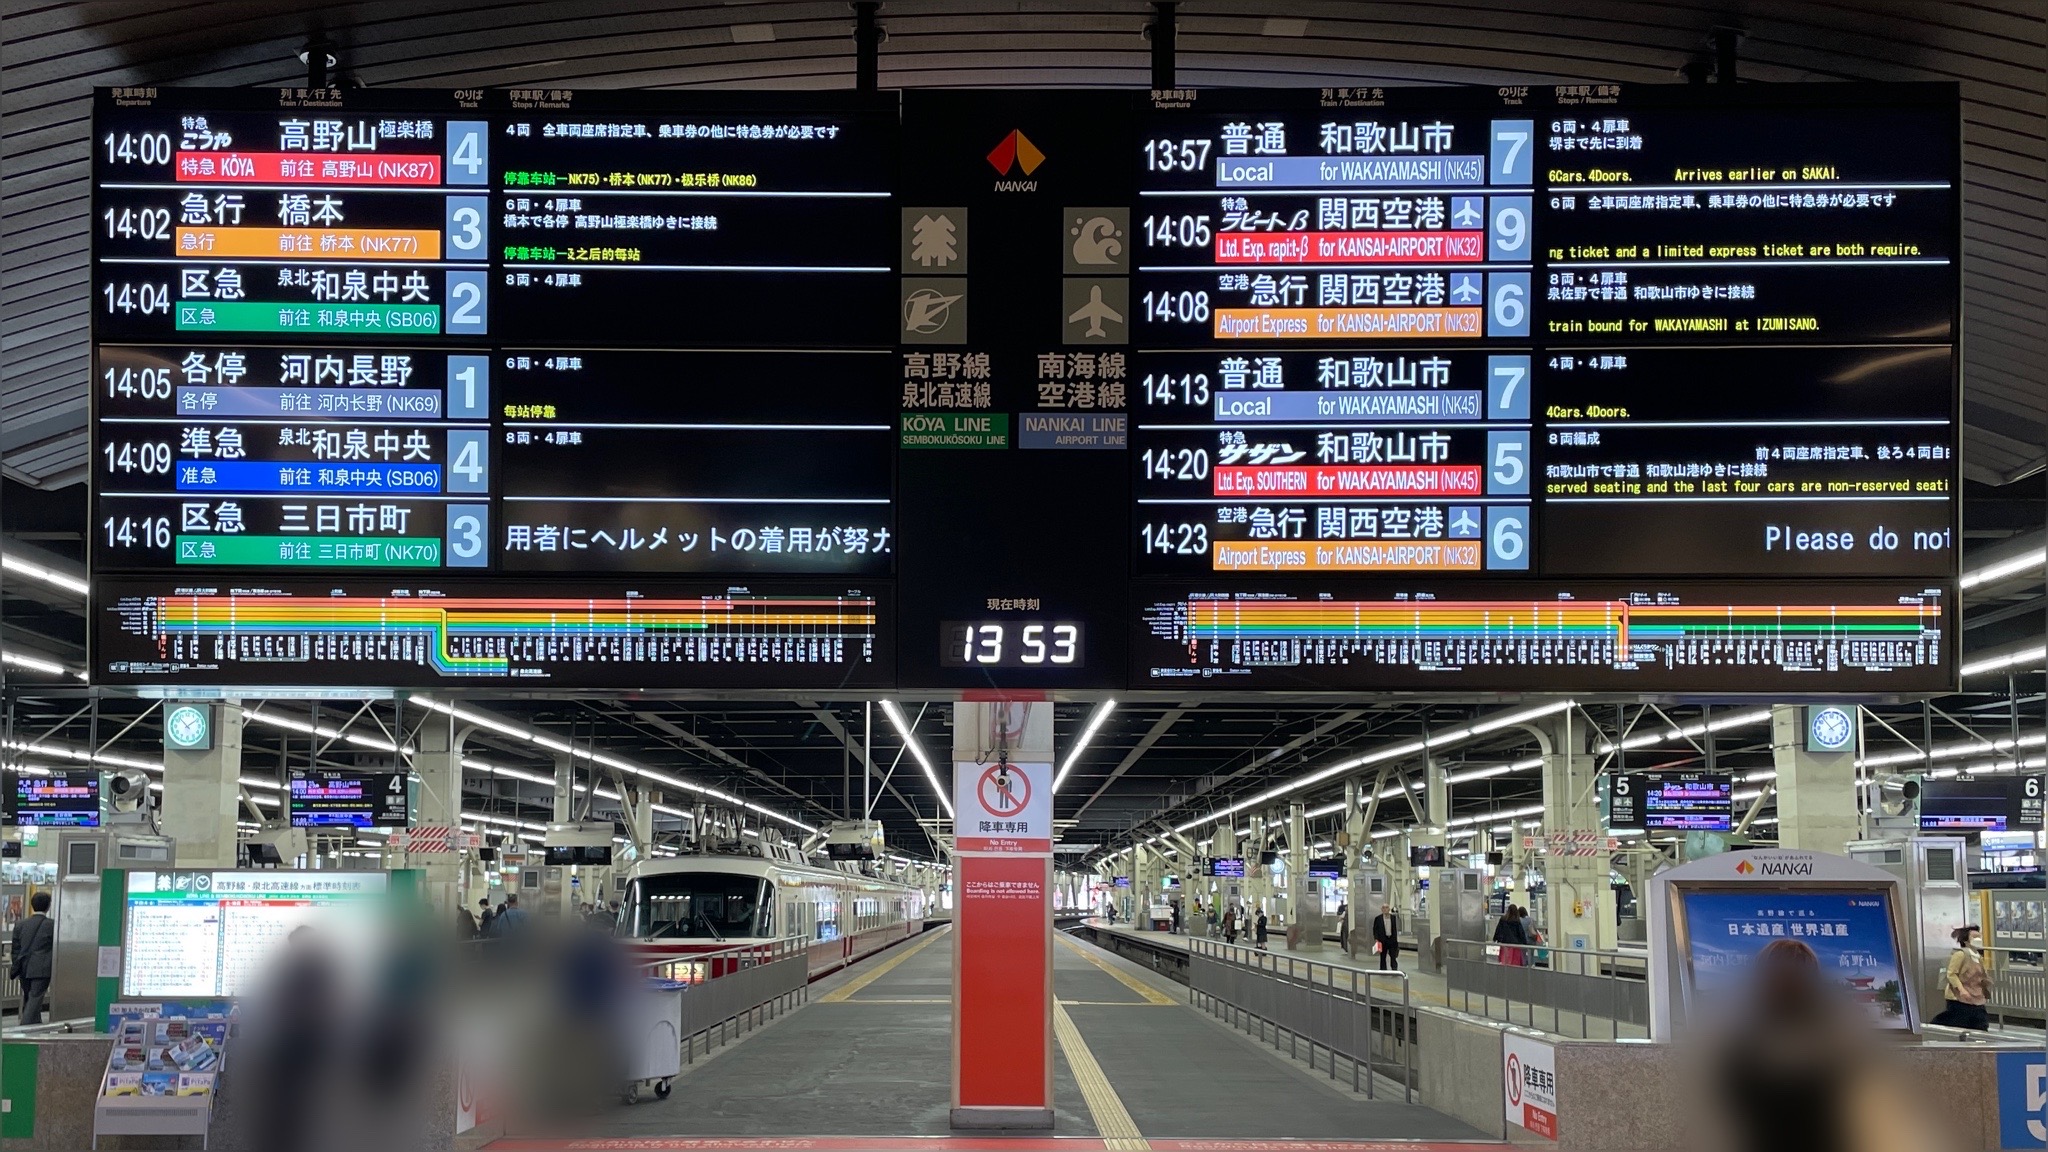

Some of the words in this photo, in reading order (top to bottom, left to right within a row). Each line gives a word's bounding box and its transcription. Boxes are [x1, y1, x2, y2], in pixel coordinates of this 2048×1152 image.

[111, 88, 157, 98] 発車時刻
[454, 89, 483, 100] のりば
[510, 90, 573, 101] 停車駅/備考
[512, 101, 532, 109] Stops
[539, 101, 570, 109] Remarks
[182, 117, 208, 130] 特急
[506, 124, 530, 137] 4両
[180, 132, 232, 150] こうや
[279, 119, 376, 152] 高野山
[379, 120, 433, 139] 極楽橋
[1221, 122, 1287, 155] 普通
[1320, 122, 1454, 153] 和歌山市
[1550, 136, 1642, 150] 堺まで先に到着
[104, 133, 170, 165] 14:00
[452, 132, 482, 174] 4
[1144, 139, 1211, 171] 13:57
[1497, 132, 1527, 174] 7
[181, 159, 215, 176] 特急
[280, 159, 314, 178] 前往
[322, 161, 372, 178] 高野山
[378, 162, 434, 180] (NK87)
[1220, 162, 1273, 182] Local
[1320, 163, 1338, 180] for
[1341, 161, 1441, 180] WAKAYAMASHI
[1444, 160, 1481, 182] (NK45)
[1675, 168, 1722, 181] Arrives
[1729, 168, 1776, 180] earlier
[1782, 170, 1796, 180] on
[1802, 168, 1839, 180] SAKAI.
[995, 181, 1037, 191] NANKAI
[181, 193, 245, 226] 急行
[278, 194, 343, 227] 橋本
[1319, 198, 1445, 230] 関西空港
[104, 208, 170, 240] 14:02
[452, 207, 481, 250] 3
[504, 215, 569, 229] 橋本で各停
[575, 215, 717, 230] 高野山極楽橋ゆきに接続
[1144, 215, 1210, 247] 14:05
[1496, 208, 1526, 251] 9
[320, 235, 354, 252] 桥本
[361, 236, 417, 254] (NK77)
[1219, 239, 1239, 258] Ltd.
[1243, 239, 1266, 260] Exp.
[1338, 237, 1443, 256] KANSAI-AIRPORT
[1446, 237, 1481, 259] (NK32)
[1549, 248, 1563, 260] ng
[1570, 246, 1610, 258] ticket
[1616, 246, 1636, 258] and
[1657, 245, 1703, 258] limited
[1709, 246, 1757, 258] express
[1836, 243, 1863, 256] both
[1870, 244, 1921, 258] require.
[181, 268, 245, 300] 区急
[278, 269, 309, 287] 泉北
[312, 270, 429, 302] 和泉中央
[1219, 274, 1248, 290] 空港
[1250, 274, 1309, 306] 急行
[1548, 286, 1627, 300] 泉佐野で普通
[1634, 286, 1755, 299] 和歌山市ゆきに接続
[104, 283, 169, 314] 14:04
[452, 283, 481, 324] 2
[1143, 291, 1209, 323] 14:08
[1494, 284, 1524, 327] 6
[385, 311, 437, 329] (SB06)
[1219, 315, 1259, 334] Airport
[1263, 316, 1307, 335] Express
[1549, 320, 1583, 332] train
[1589, 320, 1622, 331] bound
[1757, 318, 1820, 331] IZUMISANO.
[181, 352, 247, 384] 各停
[280, 354, 412, 387] 河内長野
[903, 353, 991, 379] 高野線
[1038, 353, 1126, 379] 南海線
[104, 367, 171, 399] 14:05
[456, 367, 474, 408] 1
[1142, 374, 1209, 405] 14:13
[318, 394, 382, 412] 河内长野
[387, 395, 438, 413] (NK69)
[903, 381, 991, 409] 泉北高速線
[1038, 381, 1126, 409] 空港線
[955, 418, 990, 432] LINE
[1026, 418, 1085, 432] NANKAI
[1093, 418, 1125, 432] LINE
[181, 427, 246, 459] 準急
[986, 436, 1005, 444] LINE
[1055, 436, 1098, 445] AIRPORT
[1103, 435, 1125, 444] LINE
[1549, 432, 1600, 445] 8両編成
[104, 442, 170, 474] 14:09
[1142, 448, 1208, 480] 14:20
[1218, 444, 1306, 465] サザン
[1493, 443, 1524, 485] 5
[181, 467, 216, 484] 准急
[1257, 472, 1307, 491] SOUTHERN
[1547, 464, 1639, 478] 和歌山市で普通
[1647, 464, 1767, 477] 和歌山港ゆきに接続
[1547, 481, 1588, 493] served
[1594, 480, 1640, 494] seating
[1828, 479, 1910, 492] non-reserved
[279, 505, 411, 535] 三日市町
[104, 517, 170, 548] 14:16
[1142, 523, 1208, 555] 14:23
[1766, 526, 1854, 550] Please
[1869, 526, 1898, 550] do
[384, 544, 437, 562] (NK70)
[987, 599, 1040, 610] 現在時刻
[389, 775, 401, 793] 4
[1617, 777, 1629, 795] 5
[2025, 778, 2038, 797] 6
[979, 821, 1028, 833] 降車専用
[1762, 863, 1813, 875] NANKAI
[1728, 924, 1785, 936] 日本遺産
[1791, 924, 1849, 936] 世界遺産
[1523, 1064, 1554, 1096] 降車専用
